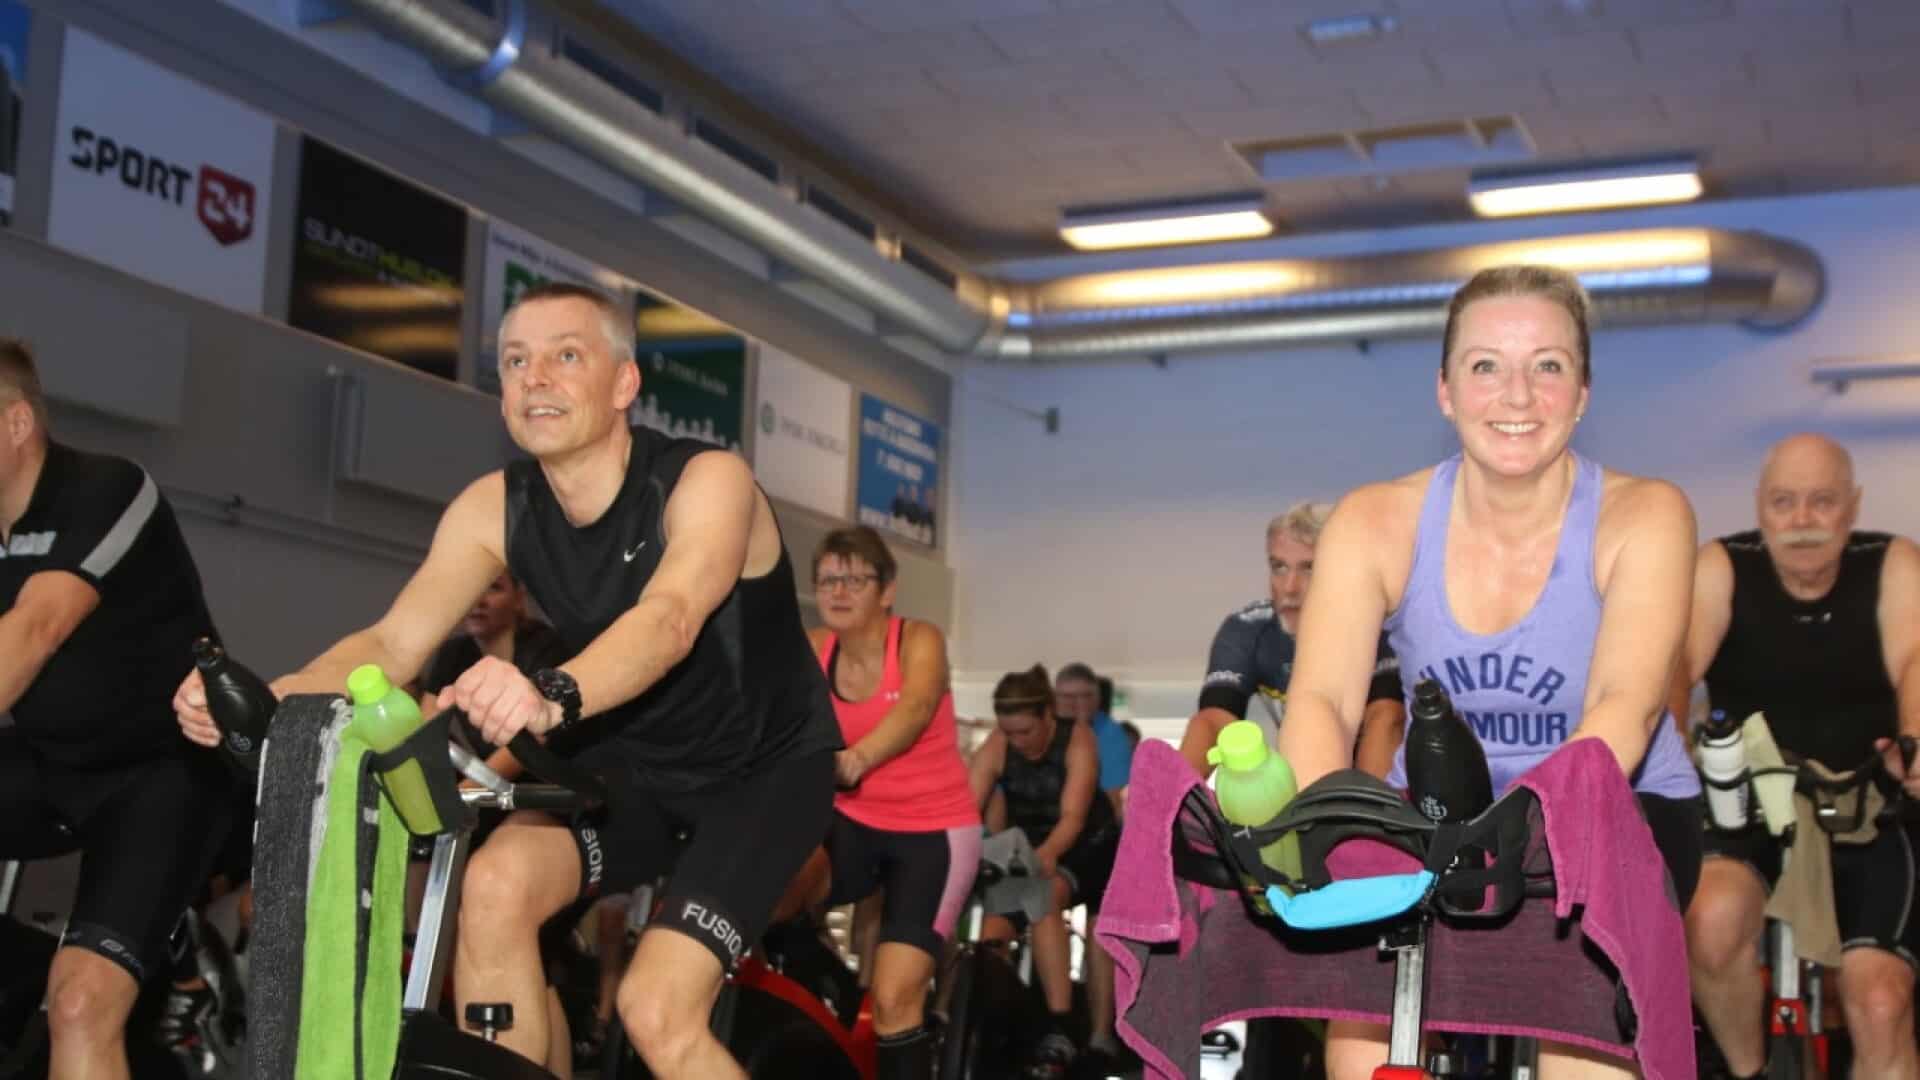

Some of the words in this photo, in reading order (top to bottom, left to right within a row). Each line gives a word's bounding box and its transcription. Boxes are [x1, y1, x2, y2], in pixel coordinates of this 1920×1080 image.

[69, 126, 191, 205] SPORT
[203, 181, 250, 234] 24
[1467, 711, 1568, 745] MOUR
